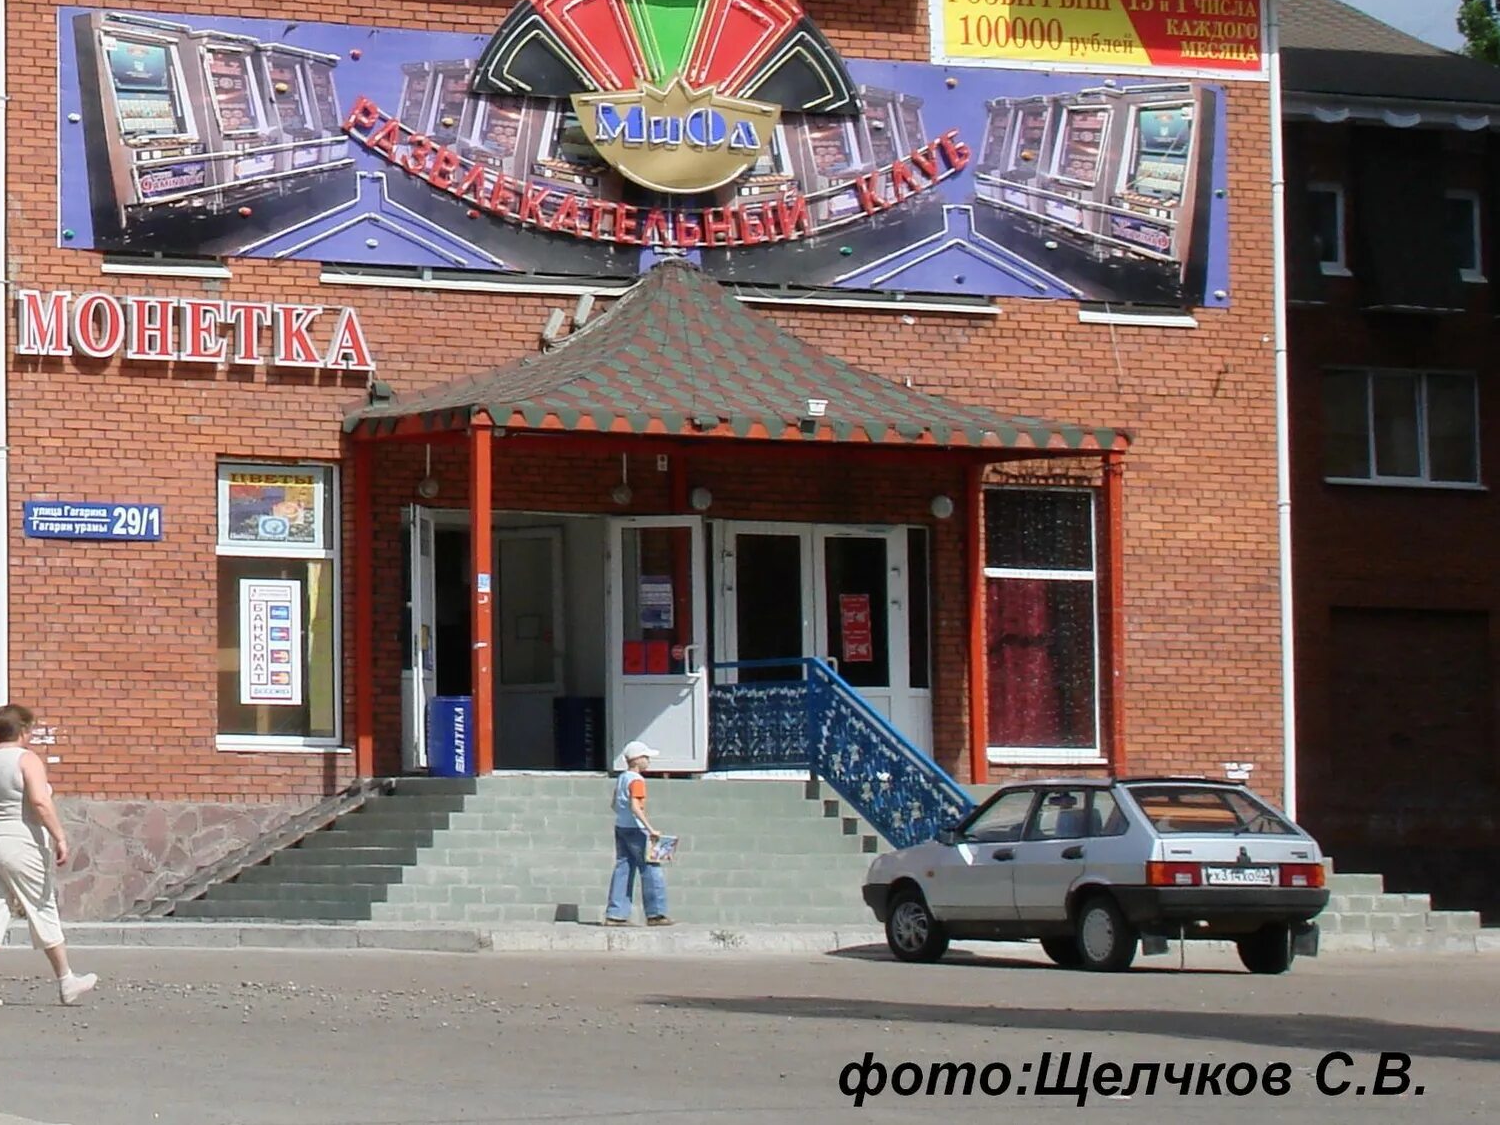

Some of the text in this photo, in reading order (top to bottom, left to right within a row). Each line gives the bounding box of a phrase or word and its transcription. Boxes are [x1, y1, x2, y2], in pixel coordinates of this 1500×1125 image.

[1159, 0, 1170, 13] и
[959, 15, 1134, 57] 100000 рублей
[1166, 18, 1258, 40] КАЖДОГО
[1180, 40, 1260, 61] МЕСЯЦА
[342, 94, 972, 247] РАЗВЛЕКАТЕЛЬНЫЙ КЛУБ
[18, 290, 377, 372] МОНЕТКА
[229, 473, 315, 484] ЦВЕТЫ
[32, 505, 107, 518] улица Гагарина
[112, 507, 160, 536] 29/1
[32, 520, 73, 533] Гагарин
[253, 603, 264, 682] БАНКОМАТ
